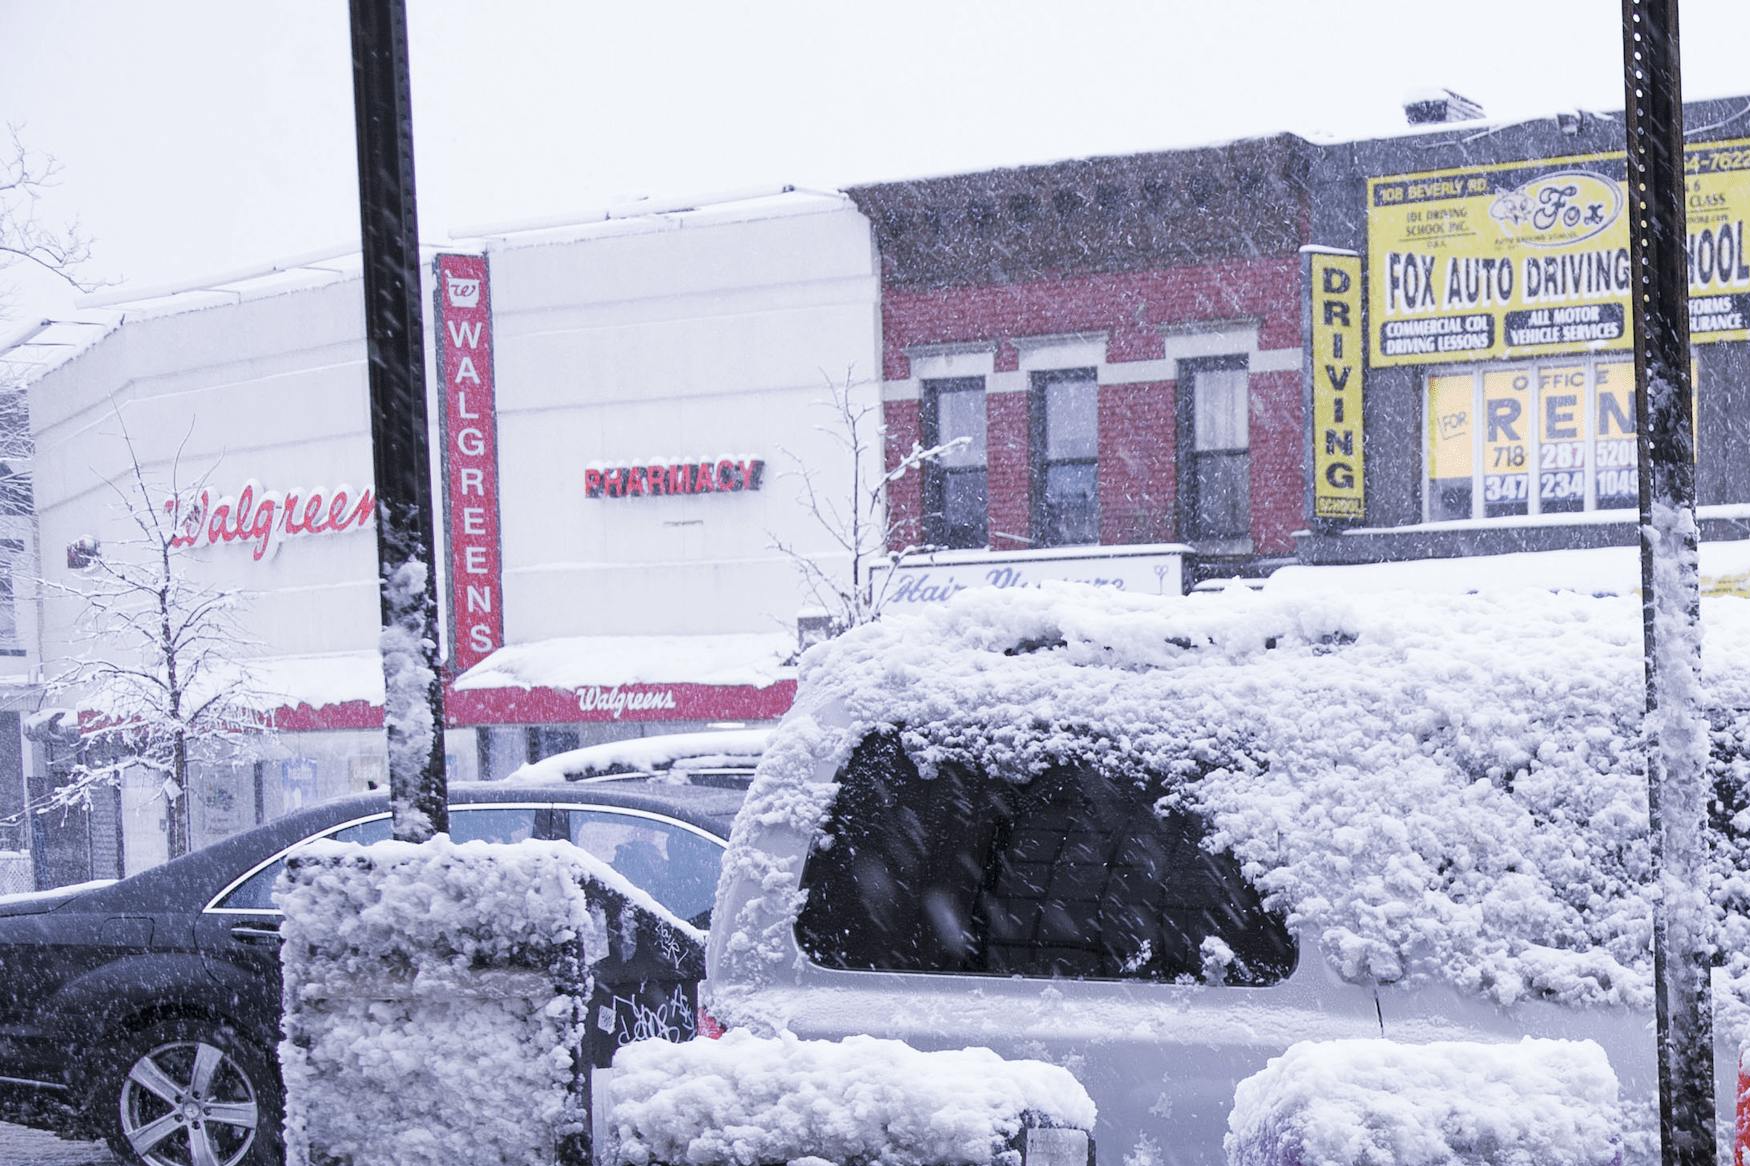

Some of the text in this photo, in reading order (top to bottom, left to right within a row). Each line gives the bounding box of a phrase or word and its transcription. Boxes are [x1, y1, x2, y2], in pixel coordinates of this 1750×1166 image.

[1407, 179, 1463, 200] BEVERLY
[1689, 192, 1726, 209] CLASS
[1425, 206, 1468, 221] DRIVING
[1533, 185, 1605, 231] Fox
[1406, 223, 1445, 238] SCHOOL
[1389, 247, 1632, 311] FOX AUTO DRIVING
[1386, 316, 1489, 339] COMMERCIAL CDL
[1528, 306, 1601, 327] ALL MOTOR
[1386, 332, 1490, 355] DRIVING LESSONS
[1510, 321, 1620, 346] VEHICLE SERVICES
[1321, 266, 1356, 490] DRIVING
[1441, 411, 1469, 434] FOR
[1486, 390, 1637, 443] REN
[1492, 445, 1526, 469] 718
[1541, 442, 1585, 469] 287
[446, 319, 494, 655] WALGREENS
[585, 460, 765, 499] PHARMACY
[1486, 473, 1529, 501] 347
[1541, 471, 1585, 498] 234
[892, 573, 968, 603] Hair
[576, 687, 677, 719] Walgreens
